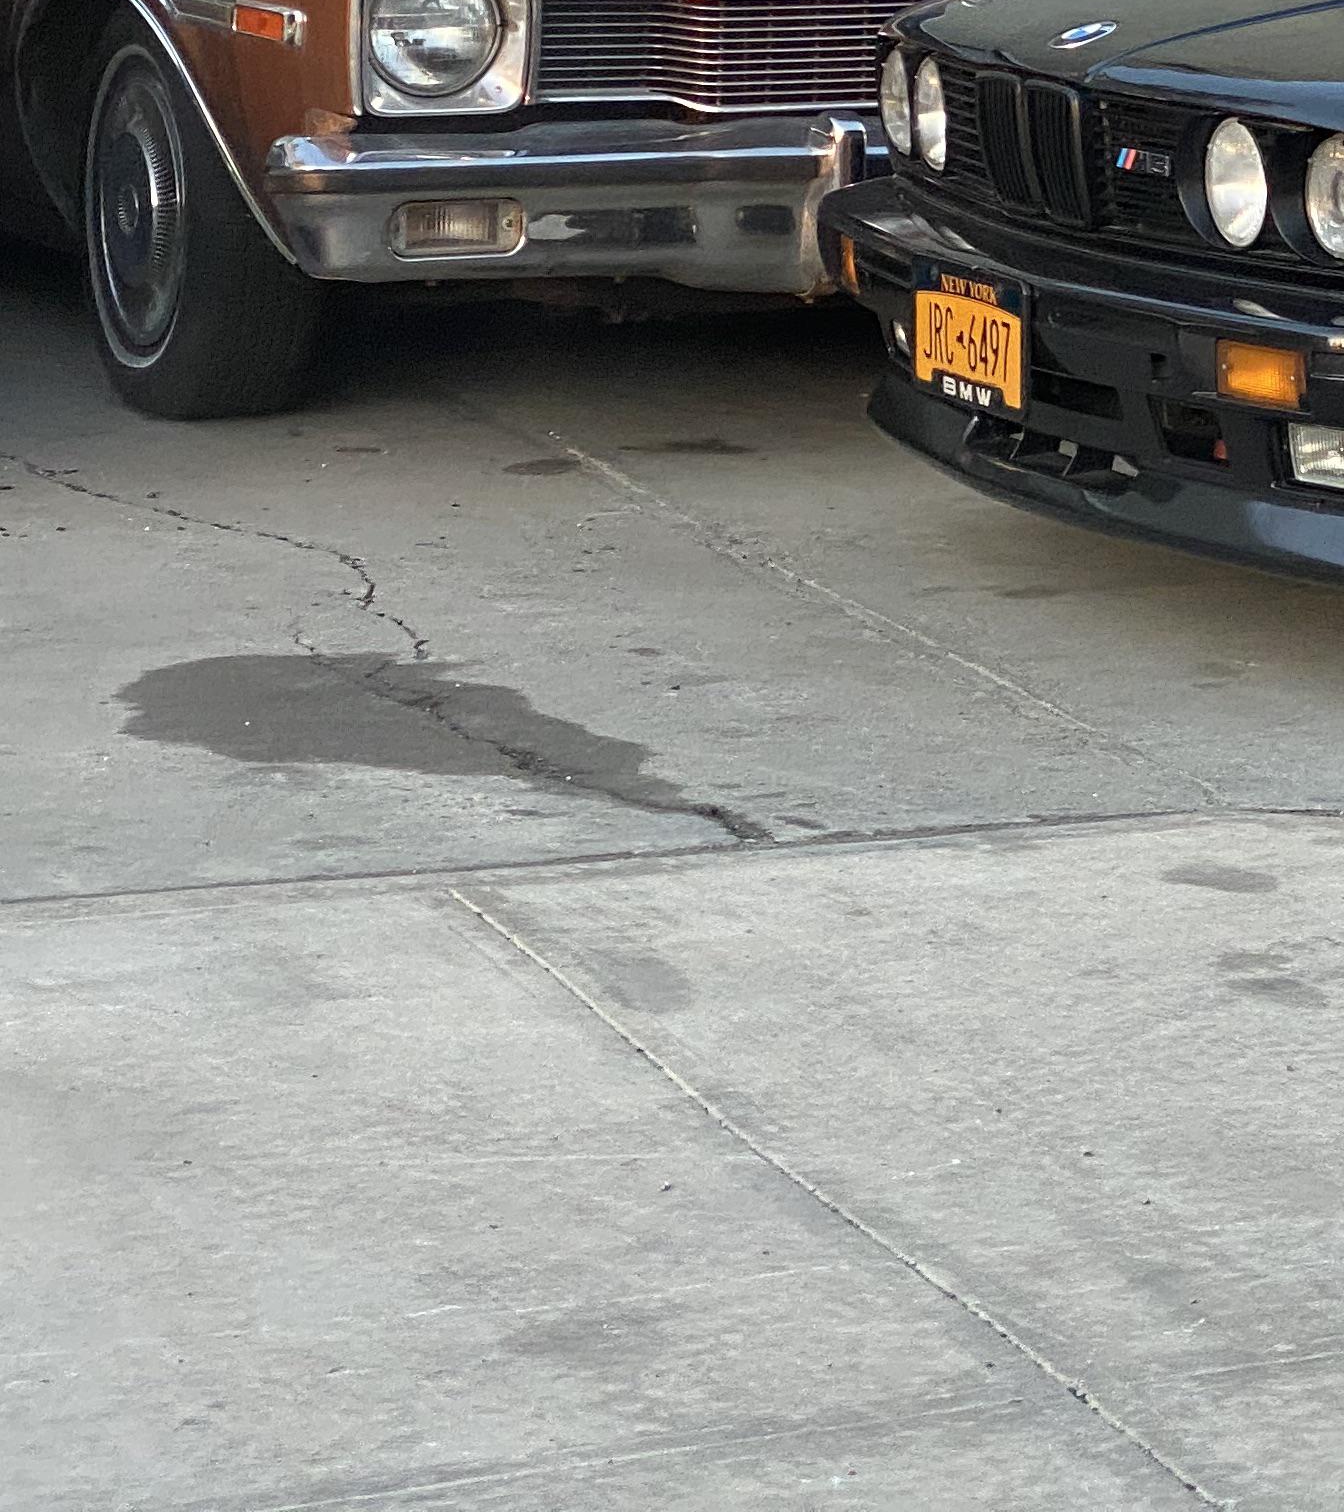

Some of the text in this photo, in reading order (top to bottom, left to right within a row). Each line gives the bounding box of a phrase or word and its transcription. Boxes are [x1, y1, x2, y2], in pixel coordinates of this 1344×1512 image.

[941, 273, 999, 306] NEW YORK
[942, 375, 992, 407] BMW
